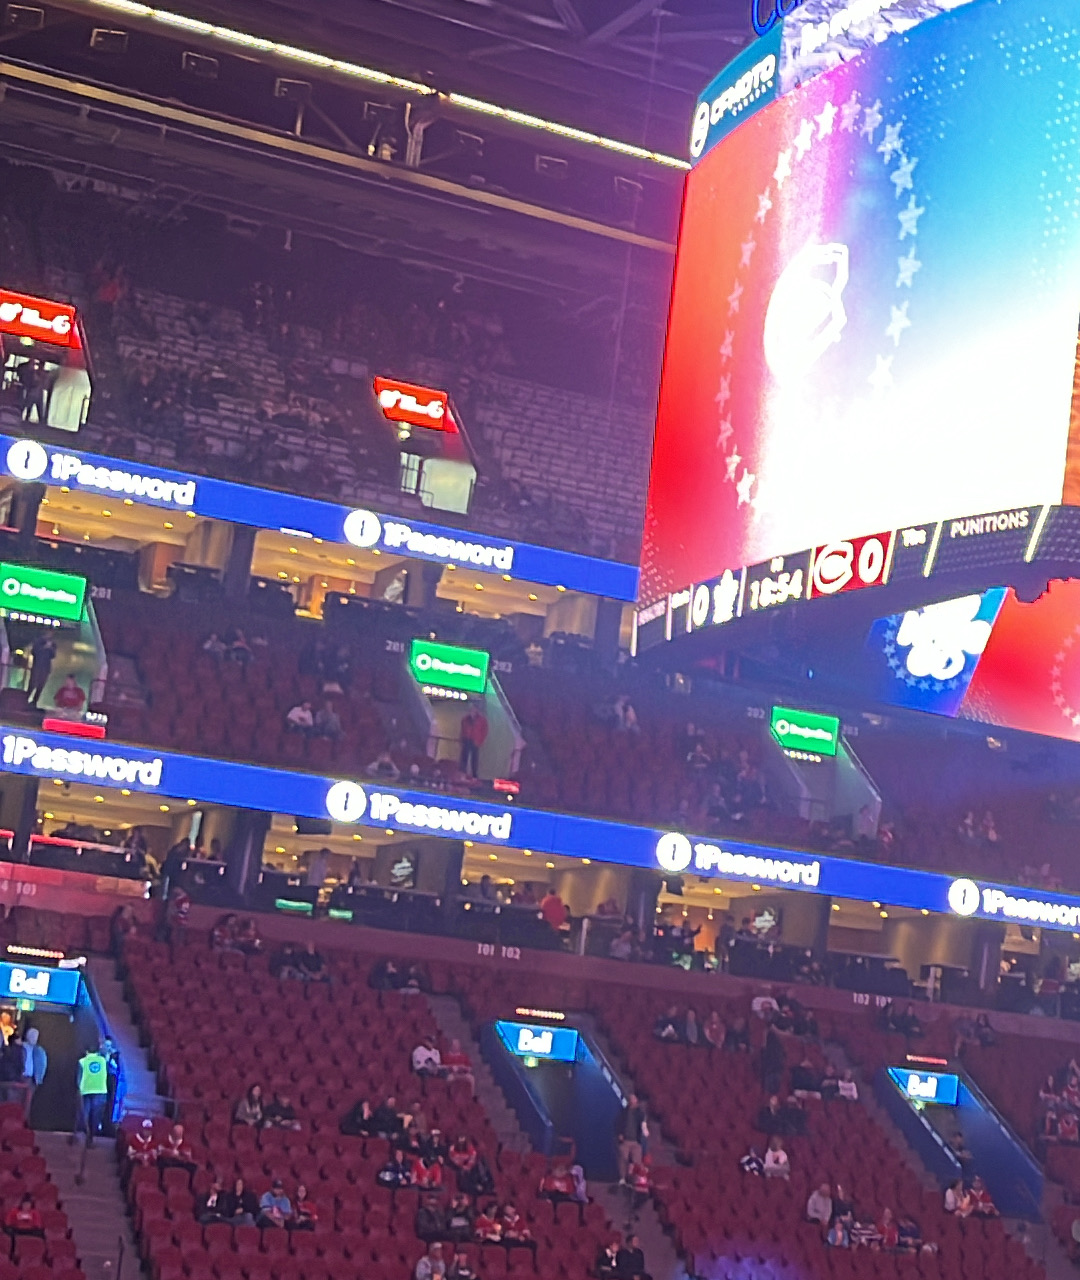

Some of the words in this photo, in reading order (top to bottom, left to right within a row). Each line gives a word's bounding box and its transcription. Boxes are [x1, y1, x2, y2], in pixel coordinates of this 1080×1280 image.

[50, 453, 196, 507] 1Password
[383, 522, 515, 571] 1Password
[950, 511, 1030, 538] PUNITIONS
[858, 538, 885, 583] 0
[693, 585, 709, 626] 0
[750, 569, 803, 612] 18:54
[1, 735, 163, 786] 1Password
[369, 791, 512, 839] 1Password
[9, 968, 50, 996] Bell
[518, 1028, 553, 1054] Bell
